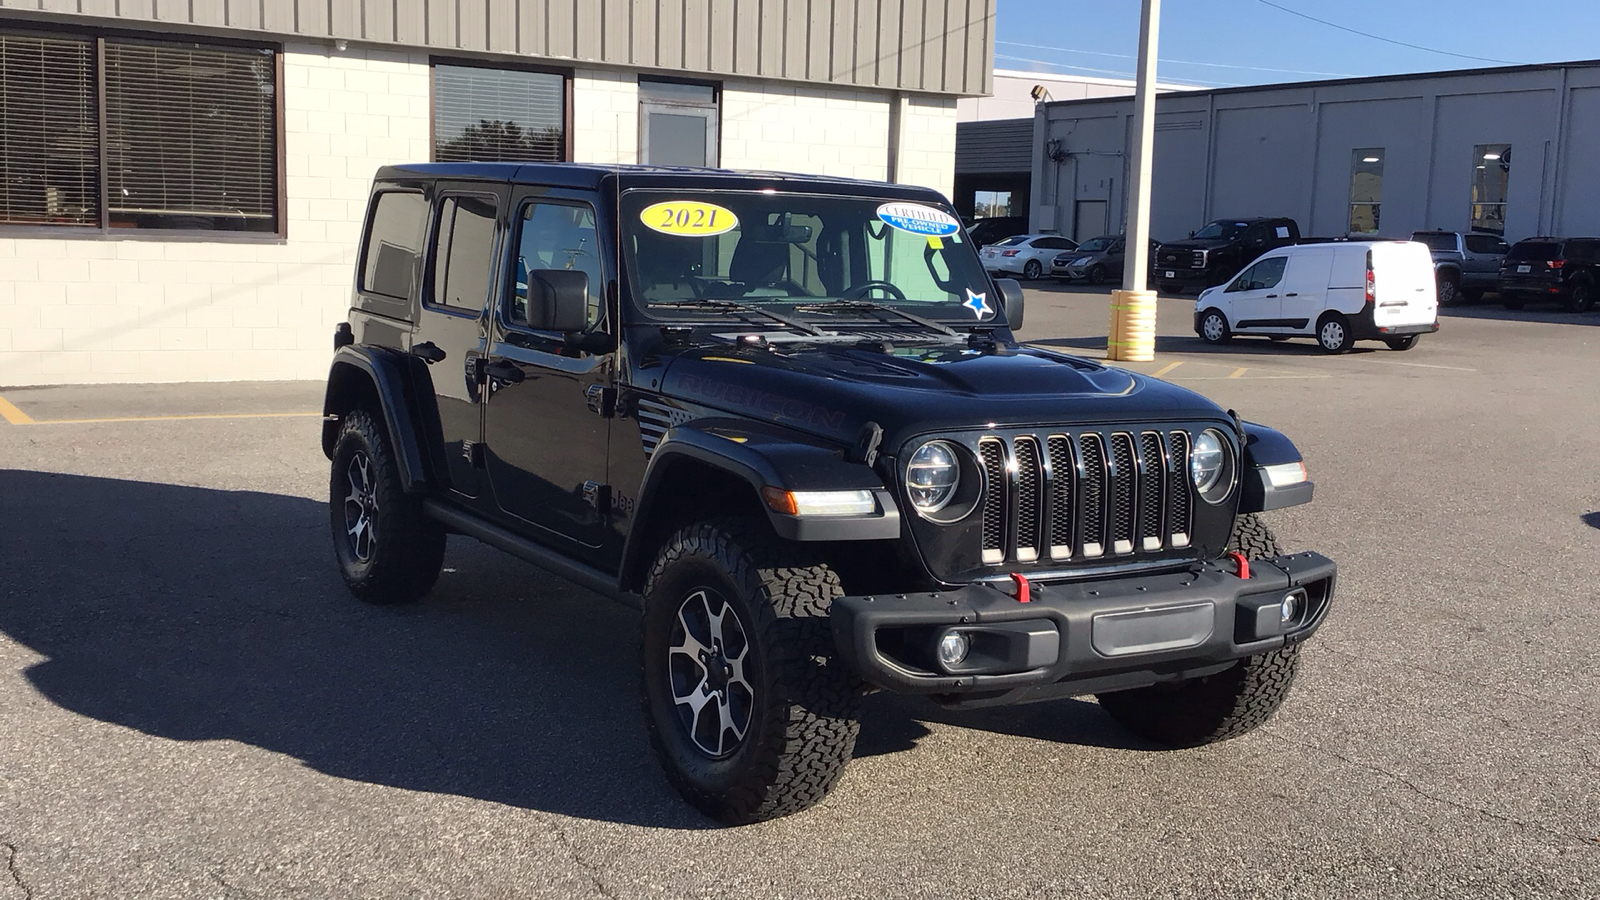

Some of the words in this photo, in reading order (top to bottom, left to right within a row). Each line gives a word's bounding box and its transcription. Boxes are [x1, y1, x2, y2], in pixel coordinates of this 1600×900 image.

[660, 208, 718, 228] 2021
[885, 206, 949, 224] CERTIFIED
[890, 216, 949, 230] PRE-OWNED
[900, 224, 943, 234] VEHICLE
[676, 372, 847, 431] RUBICON
[611, 489, 635, 512] Jee
